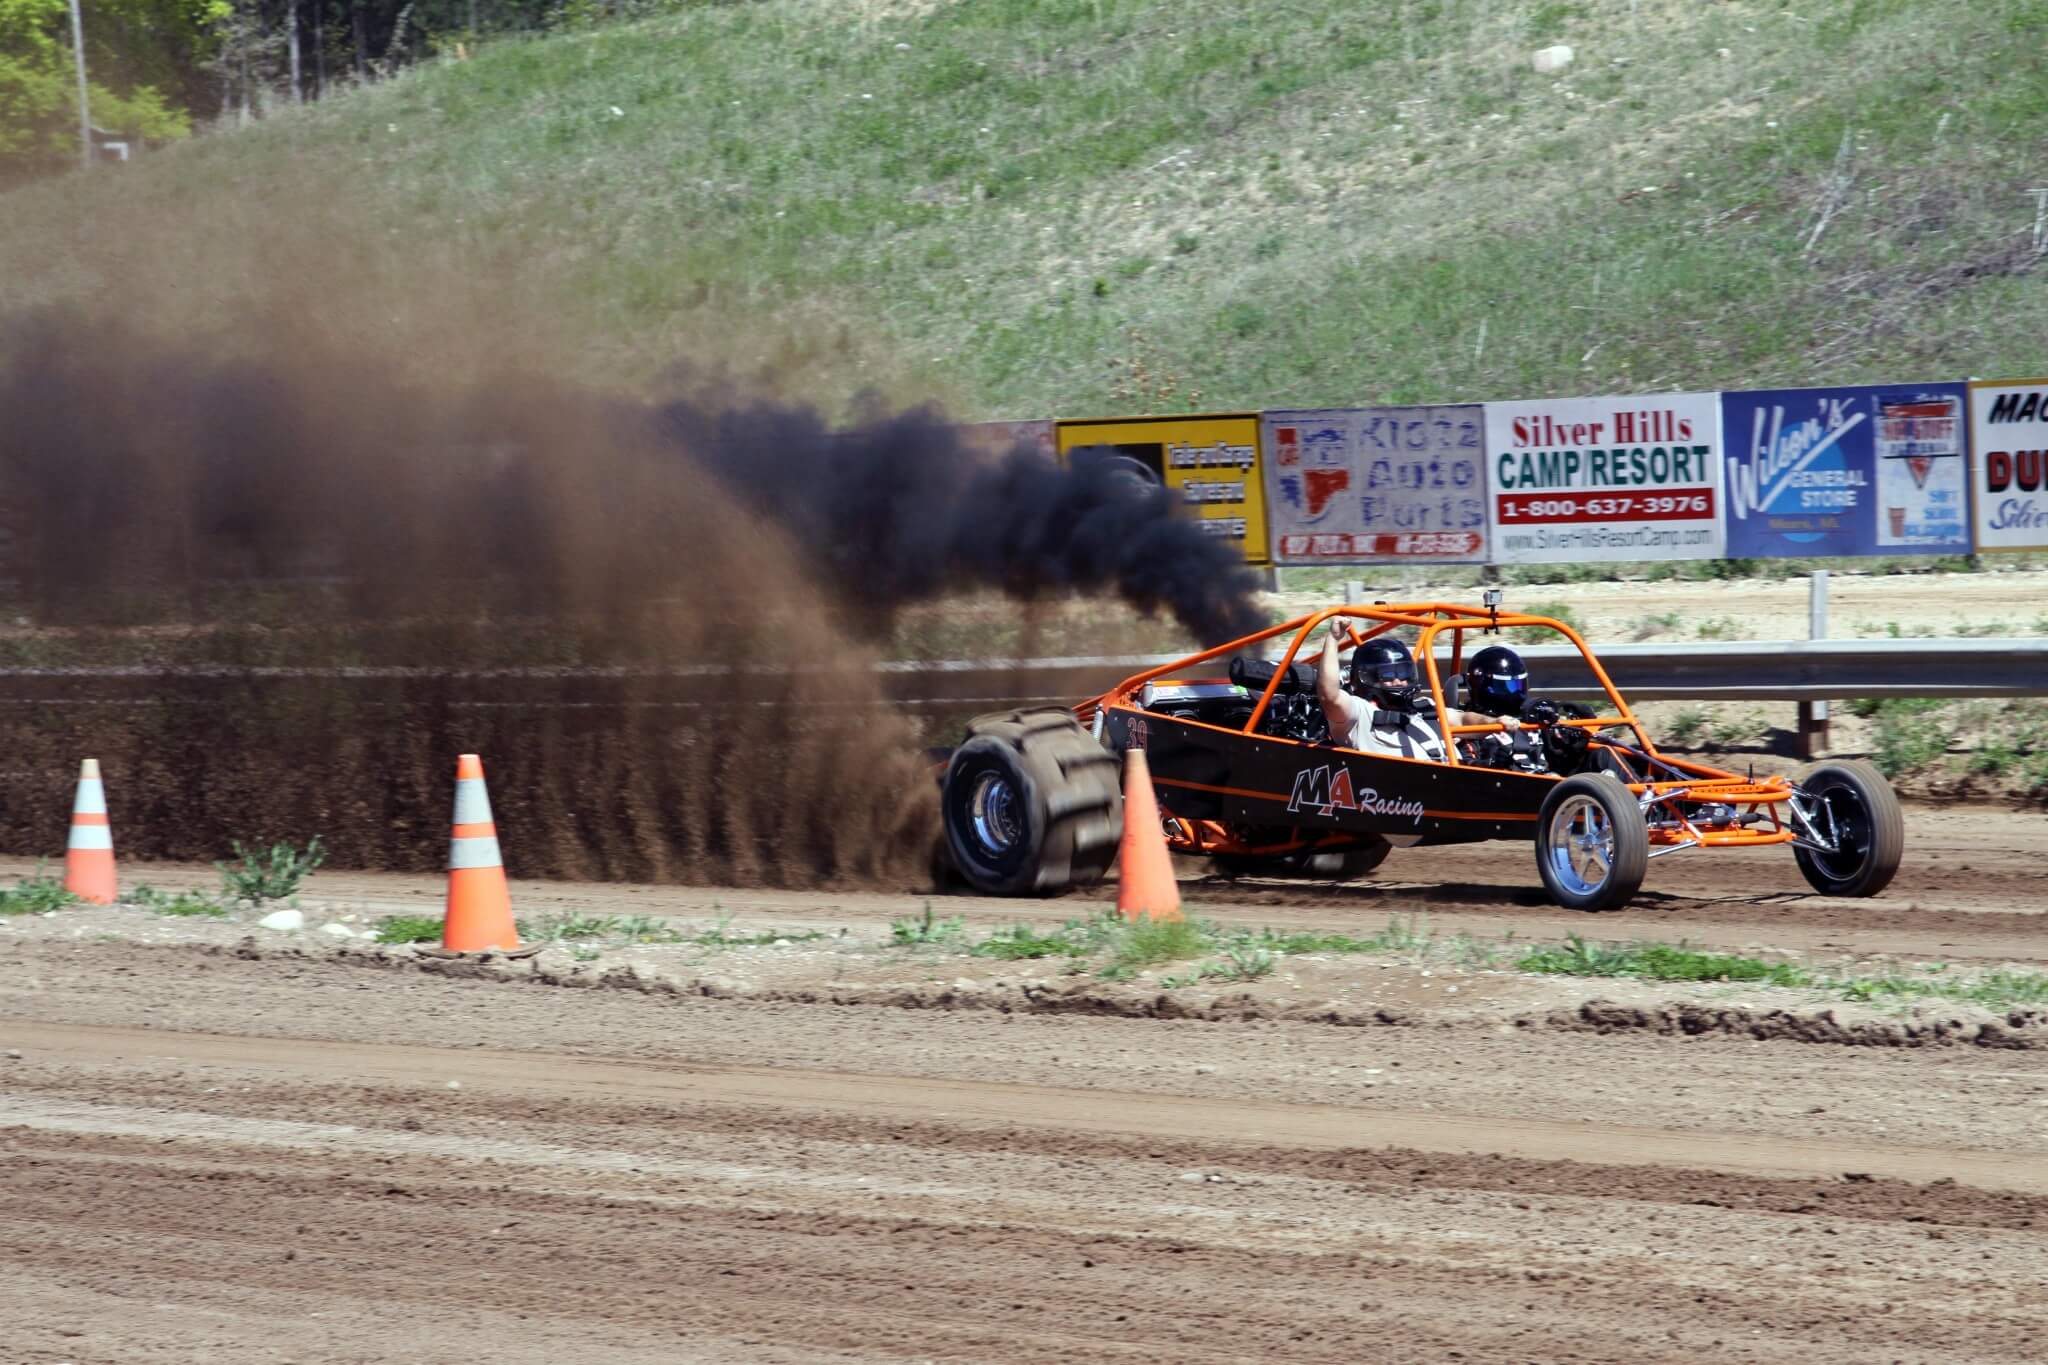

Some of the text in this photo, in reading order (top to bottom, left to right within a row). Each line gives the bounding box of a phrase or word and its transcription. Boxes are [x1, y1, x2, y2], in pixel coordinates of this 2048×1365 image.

[1512, 410, 1692, 448] Silver Hills
[1368, 456, 1476, 489] Auto
[1497, 445, 1711, 489] CAMP/RESORT
[1791, 469, 1868, 488] GENERAL
[1987, 450, 2048, 493] DU
[1503, 496, 1709, 517] 1-800-637-3976
[1801, 490, 1857, 508] STORE
[1287, 764, 1424, 825] MA Racing
